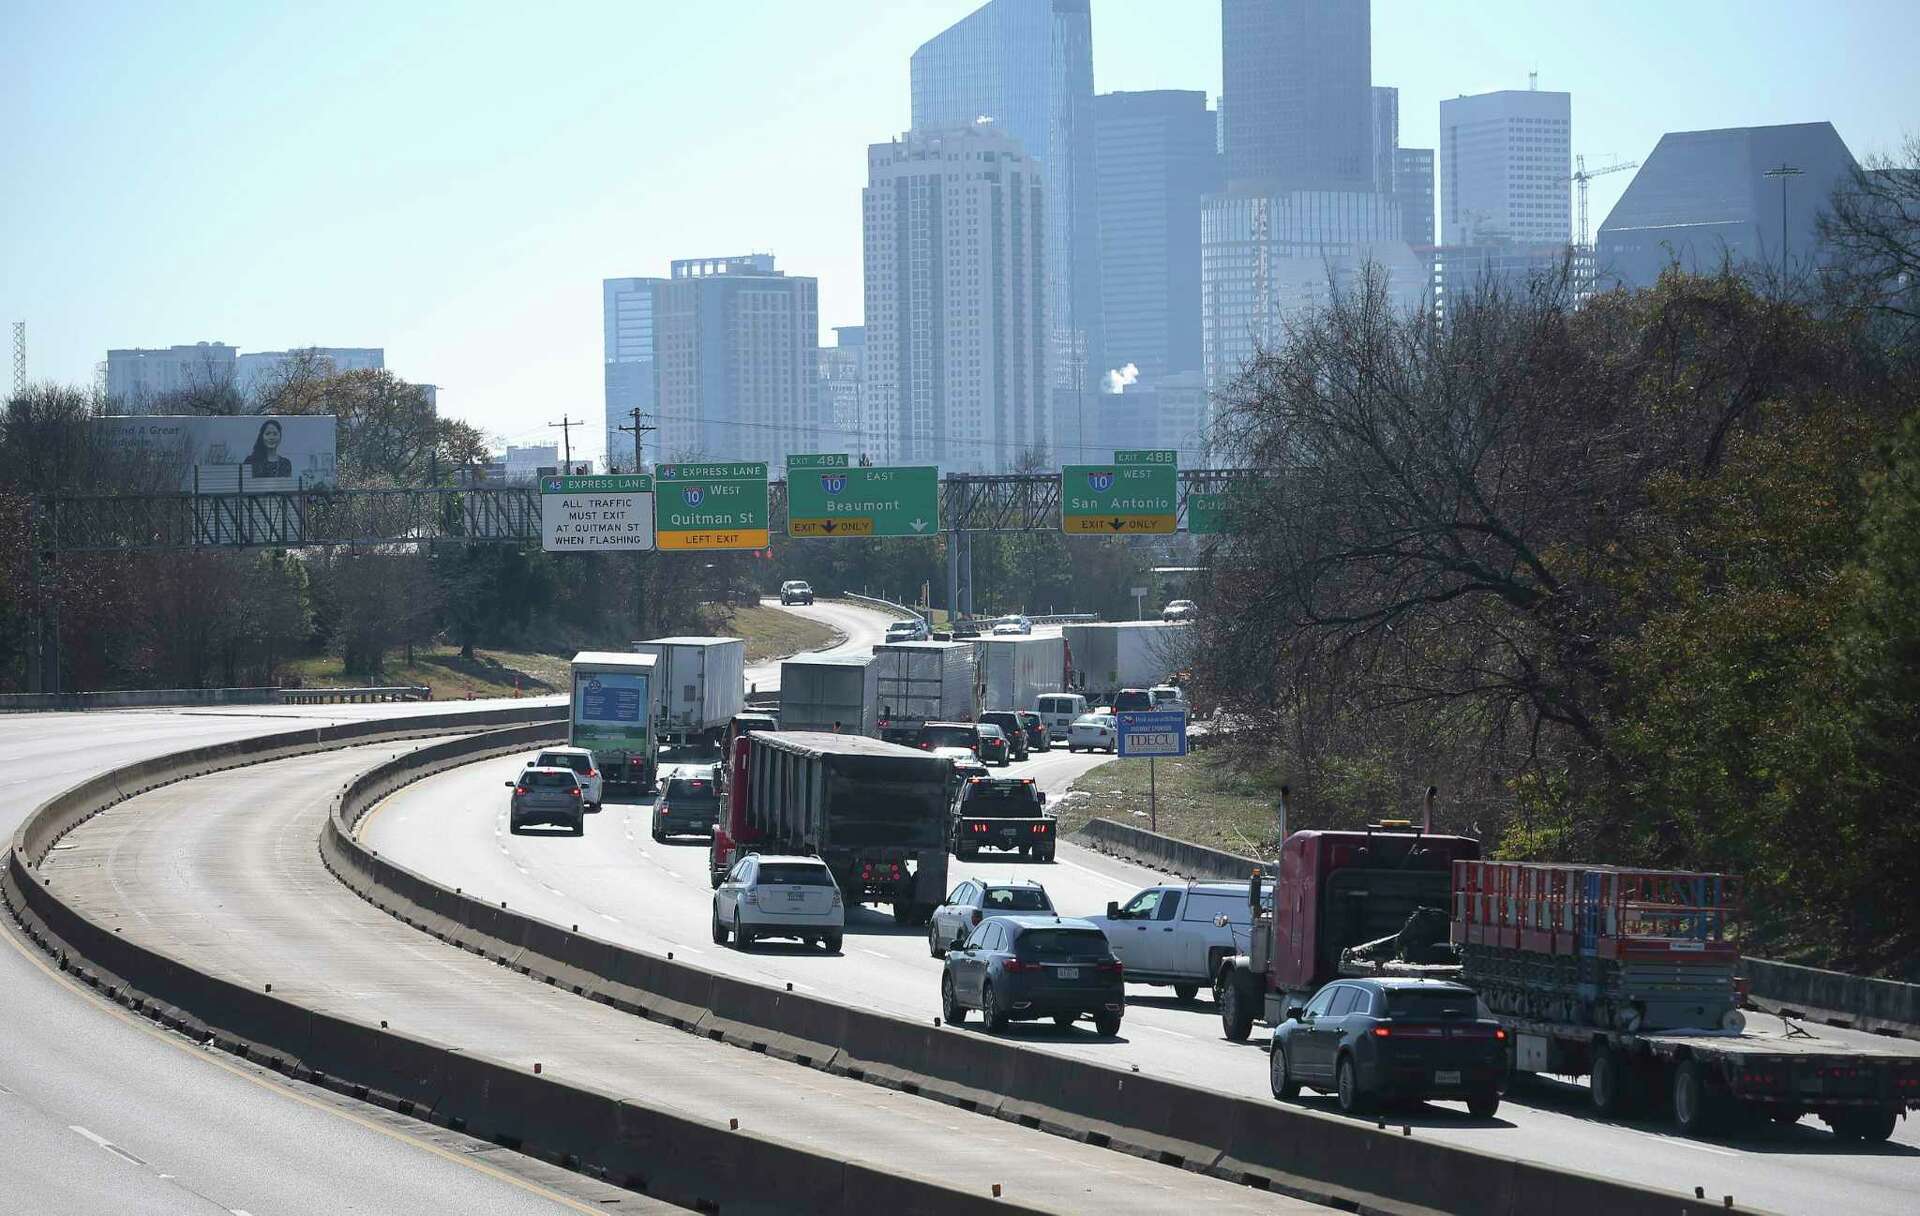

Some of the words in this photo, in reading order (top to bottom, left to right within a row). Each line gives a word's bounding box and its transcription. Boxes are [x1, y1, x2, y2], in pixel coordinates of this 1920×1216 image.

[790, 457, 808, 465] EXIT
[816, 455, 845, 465] 48A
[1118, 454, 1137, 462] EXIT
[1145, 452, 1173, 463] 48B
[663, 469, 676, 478] 45
[682, 467, 728, 477] EXPRESS
[733, 466, 760, 475] LANE
[866, 471, 894, 481] EAST
[1123, 469, 1152, 479] WEST
[550, 481, 562, 490] 45
[568, 480, 614, 489] EXPRESS
[619, 479, 646, 488] LANE
[827, 479, 841, 491] 10
[1093, 477, 1108, 488] 10
[687, 491, 699, 503] 10
[562, 499, 583, 508] ALL
[589, 498, 633, 507] TRAFFIC
[827, 500, 899, 512] Beaumont
[1072, 498, 1098, 509] San
[1110, 497, 1168, 509] Antonio
[569, 511, 597, 520] MUST
[603, 511, 625, 520] EXIT
[671, 513, 732, 525] Quitman
[739, 511, 754, 523] St
[556, 524, 569, 533] AT
[575, 523, 622, 532] QUITMAN
[627, 523, 640, 532] ST
[794, 522, 816, 532] EXIT
[841, 522, 870, 531] ONLY
[1081, 519, 1104, 529] EXIT
[1128, 519, 1158, 529] ONLY
[555, 536, 584, 545] WHEN
[589, 535, 641, 544] FLASHING
[685, 535, 711, 544] LEFT
[716, 534, 739, 544] EXIT
[1128, 734, 1175, 746] TDECU
